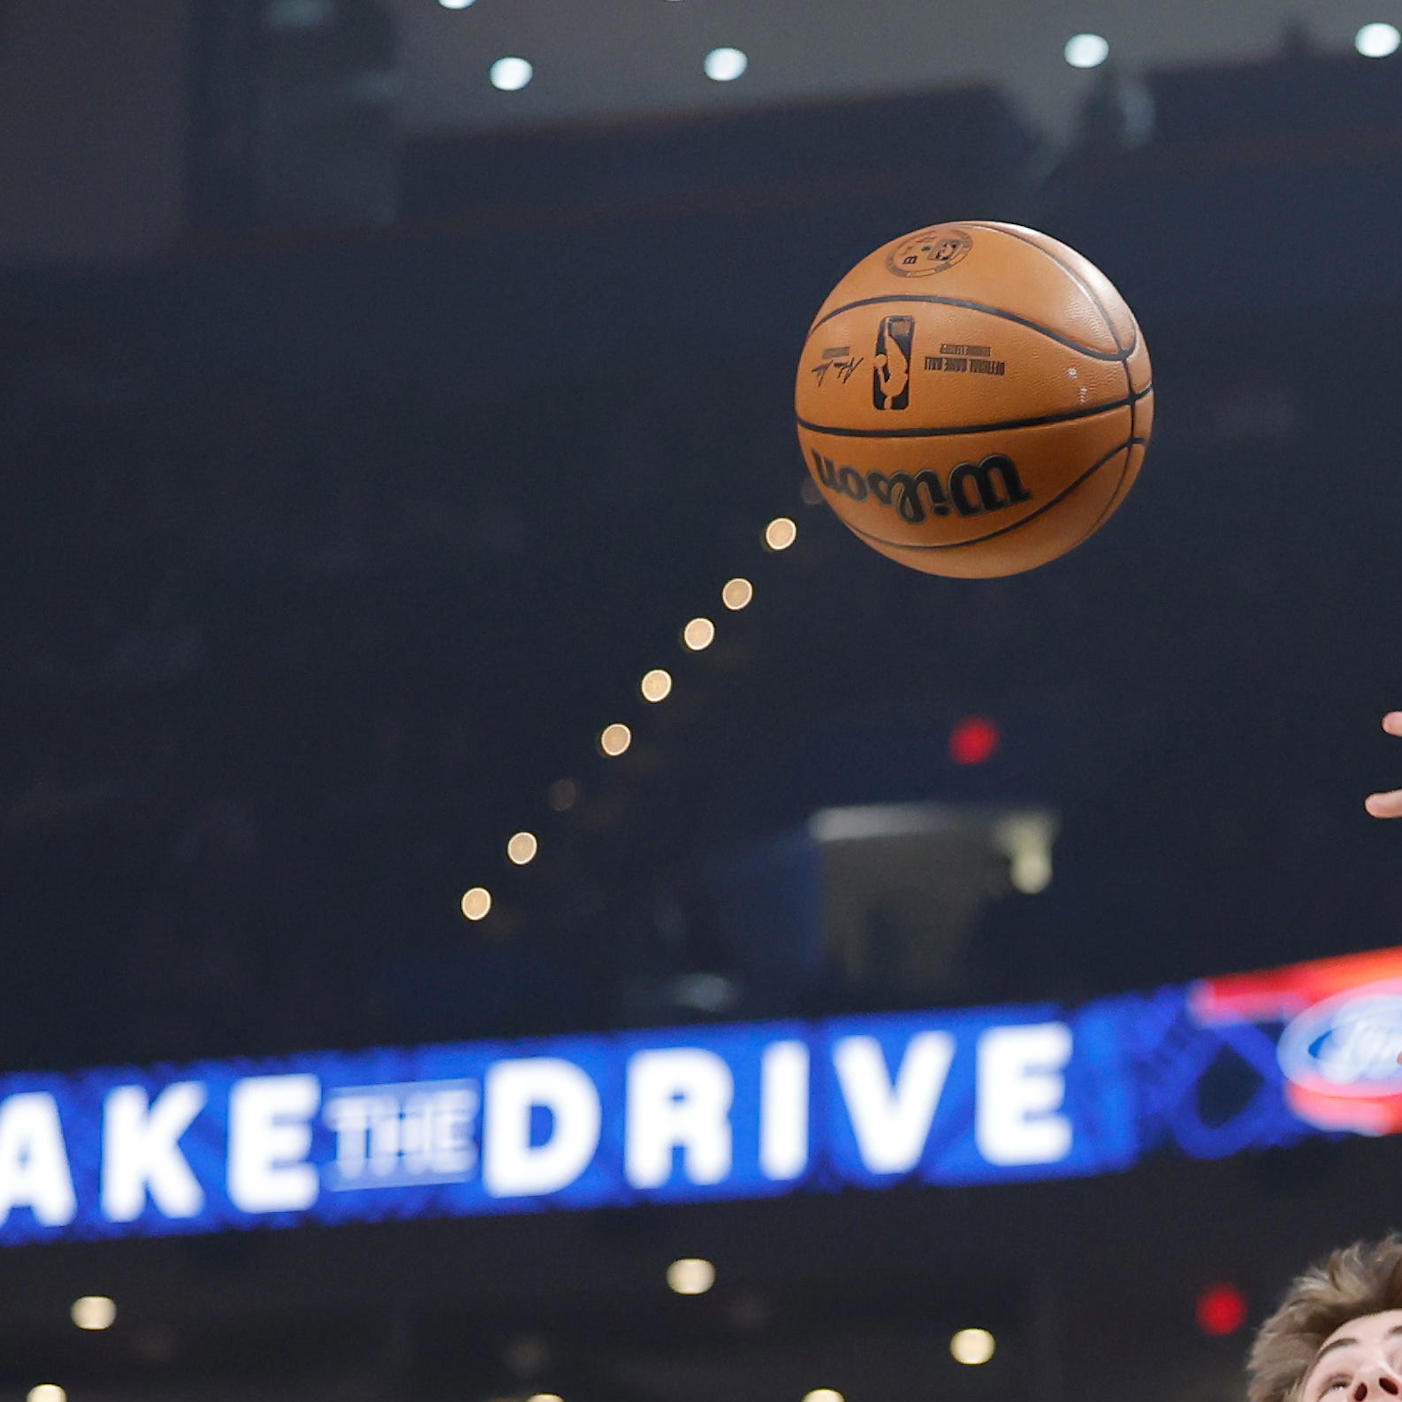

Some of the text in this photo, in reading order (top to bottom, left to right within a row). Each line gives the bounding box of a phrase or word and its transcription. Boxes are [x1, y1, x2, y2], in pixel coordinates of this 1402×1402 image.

[811, 449, 1032, 525] Wilson
[323, 1088, 480, 1181] THE
[482, 1020, 1074, 1199] DRIVE
